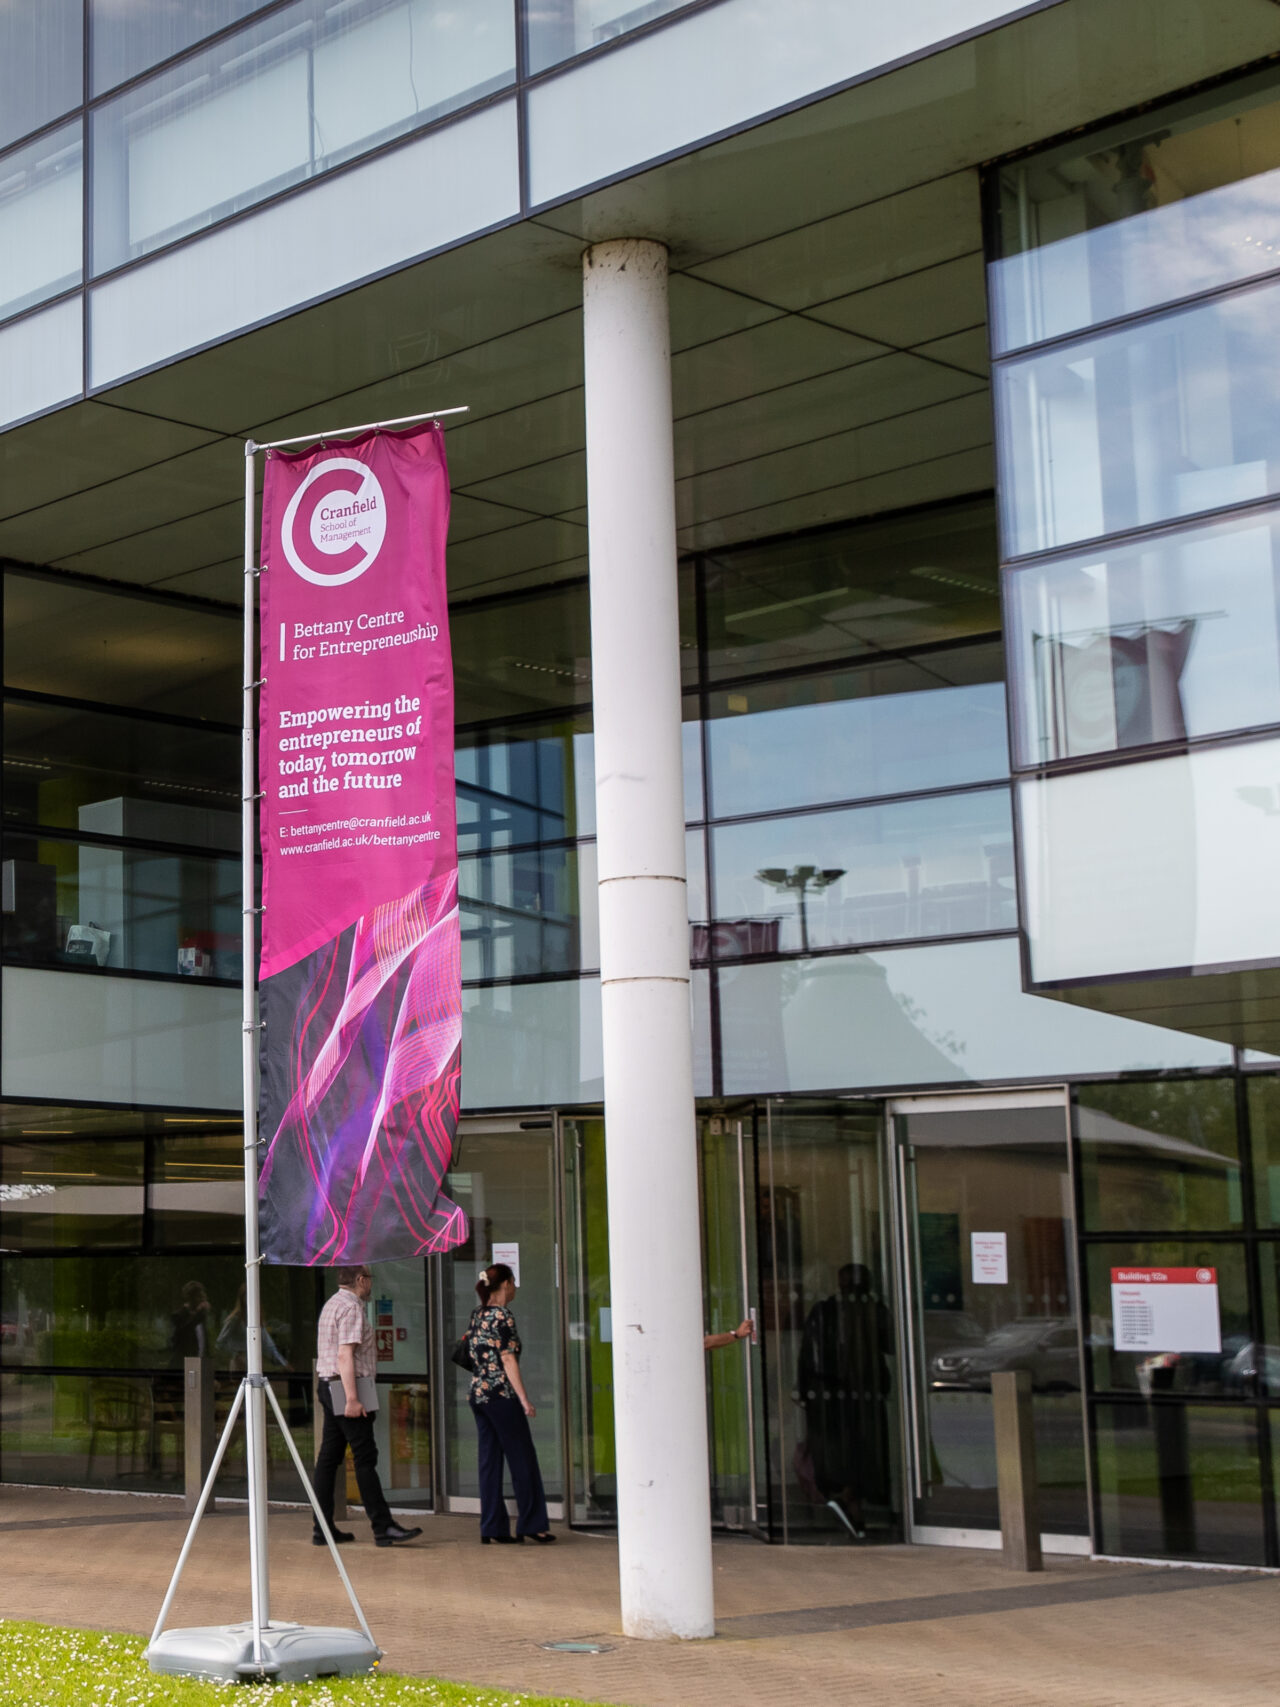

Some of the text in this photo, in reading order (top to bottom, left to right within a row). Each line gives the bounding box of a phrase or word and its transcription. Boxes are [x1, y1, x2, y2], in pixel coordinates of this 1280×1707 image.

[320, 496, 377, 521] Cranfield
[320, 517, 357, 533] School of
[320, 526, 371, 543] Management
[294, 610, 405, 639] Bettany Centre
[292, 622, 439, 661] for Entrepreneurship
[279, 694, 421, 729] Empowering the
[279, 715, 422, 752] entrepreneurs of
[278, 745, 417, 776] today, tomorrow
[278, 771, 403, 799] and the future
[279, 811, 432, 838] E: bettanycentre@cranfield.ac.uk
[280, 830, 441, 856] www.cranfield.ac.uk/bettanycentre
